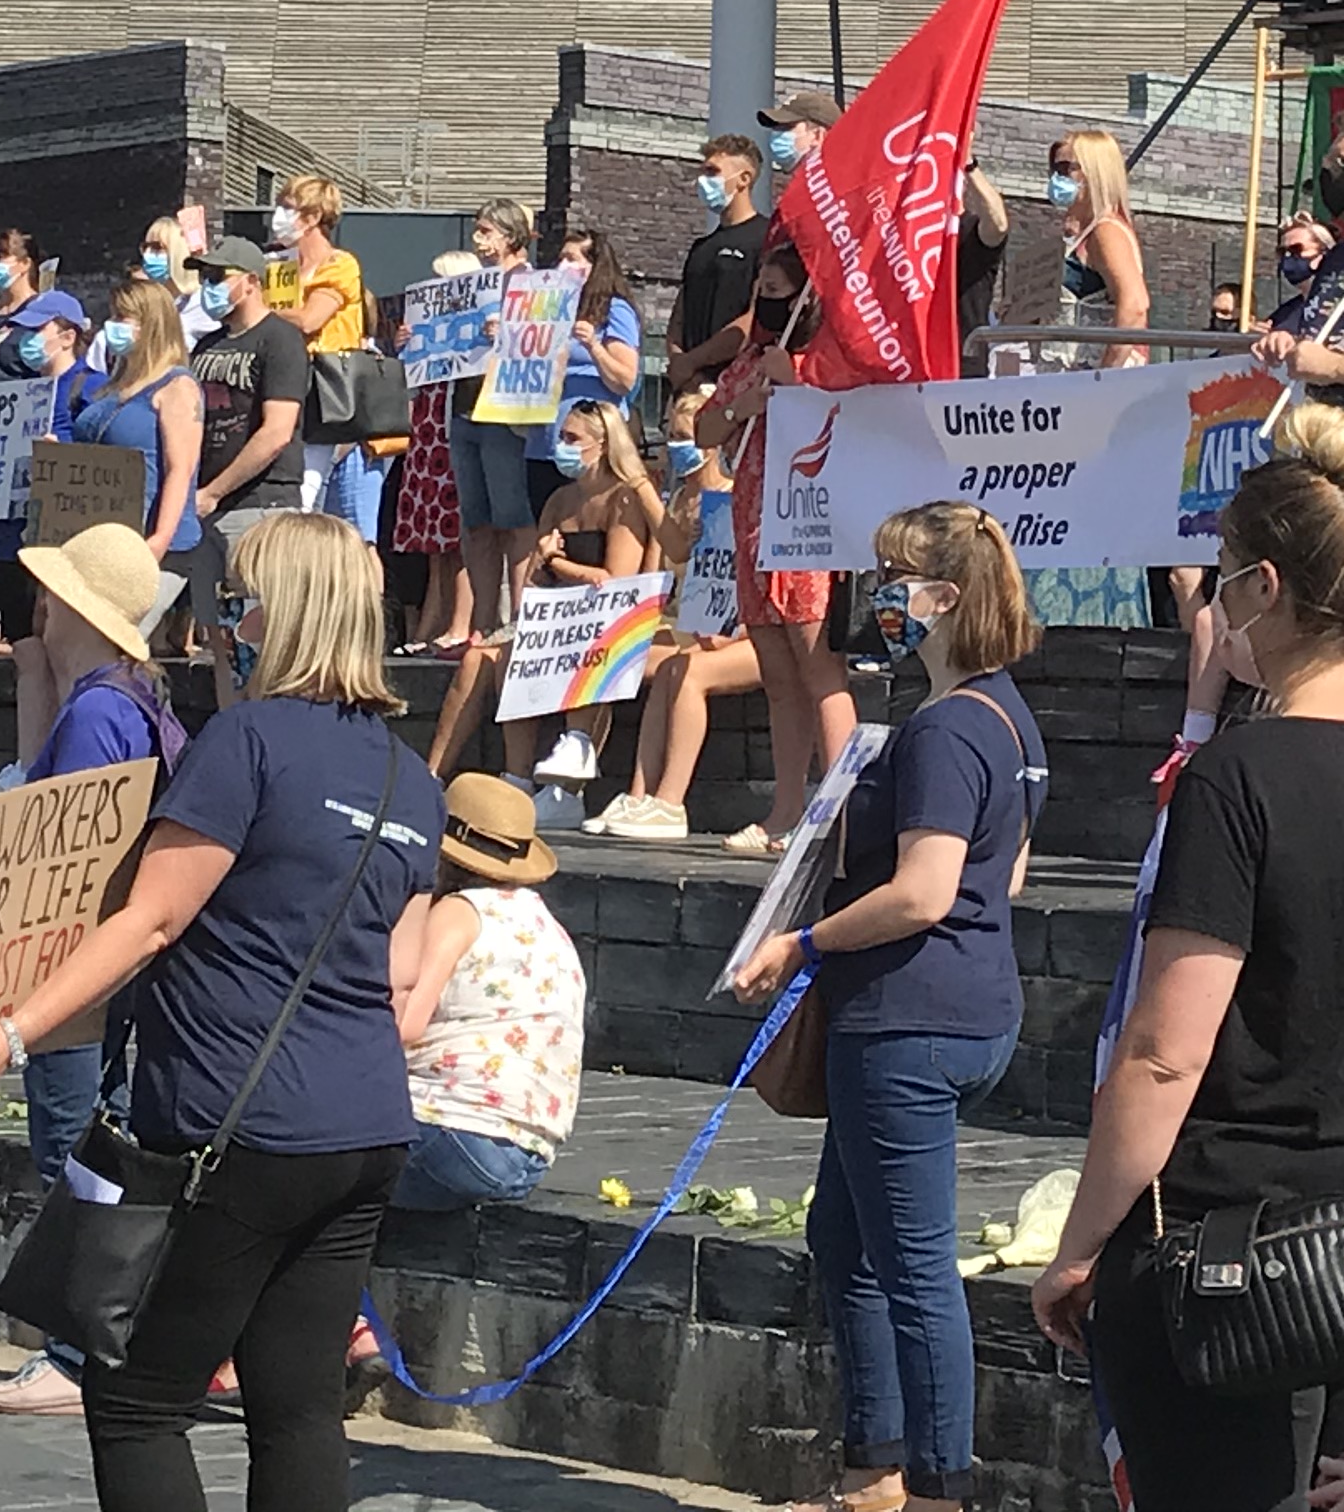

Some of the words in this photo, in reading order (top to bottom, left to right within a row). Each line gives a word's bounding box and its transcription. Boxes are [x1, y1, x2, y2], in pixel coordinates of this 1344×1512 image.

[476, 272, 501, 292] ARE
[505, 289, 575, 322] THANK
[507, 324, 555, 358] YOU
[944, 402, 1015, 436] Unite
[1021, 399, 1062, 432] for
[34, 460, 57, 482] IT
[68, 464, 87, 485] IS
[93, 466, 122, 487] OUR
[959, 466, 978, 491] a
[978, 461, 1077, 500] proper
[1011, 513, 1069, 547] Rise
[524, 602, 550, 622] WE
[552, 592, 609, 616] FOUGHT
[609, 588, 640, 610] FOR
[516, 631, 549, 650] YOU
[551, 621, 605, 648] PLEASE
[508, 657, 555, 680] FIGHT
[554, 651, 581, 676] FOR
[581, 647, 610, 669] US!
[19, 857, 100, 930] LIFE
